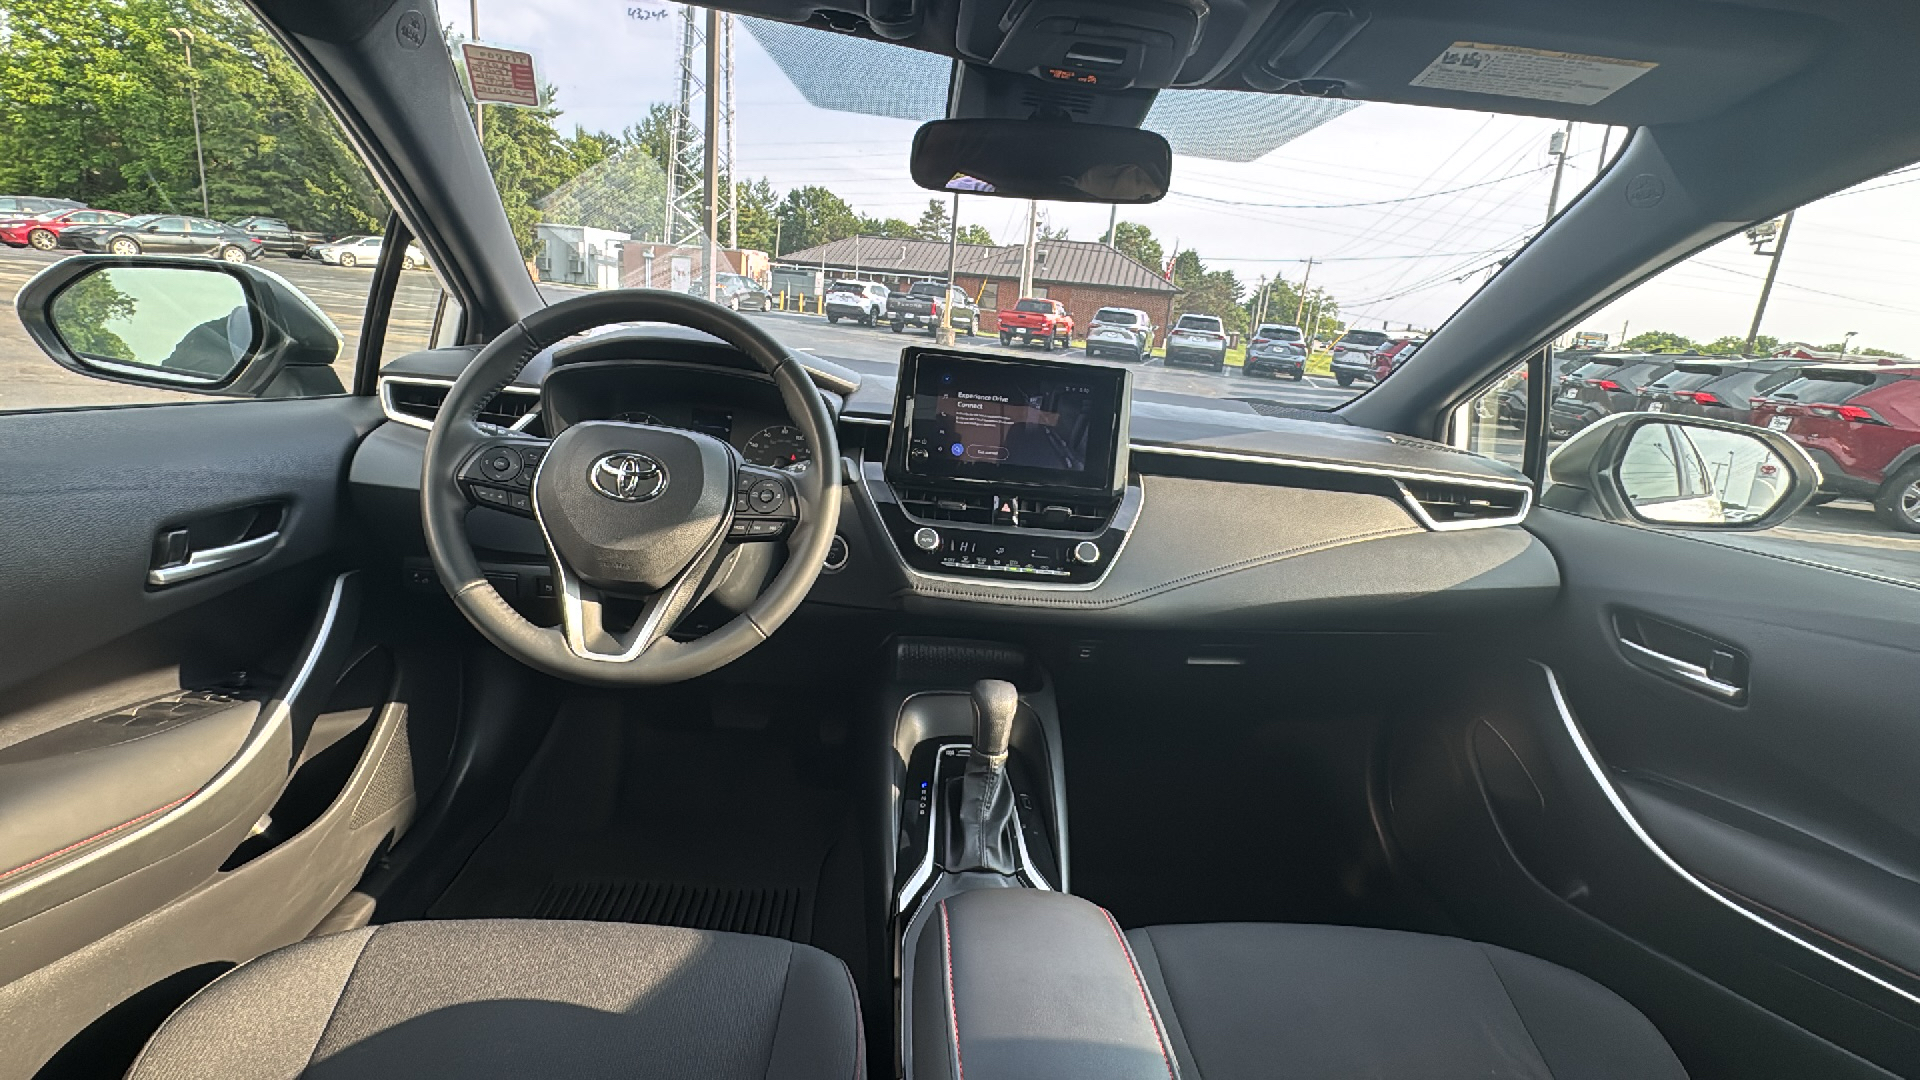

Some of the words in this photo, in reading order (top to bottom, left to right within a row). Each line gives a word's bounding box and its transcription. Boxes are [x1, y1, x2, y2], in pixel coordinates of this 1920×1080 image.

[957, 391, 991, 401] Experience
[992, 395, 1009, 403] Drive
[957, 401, 983, 410] Connect
